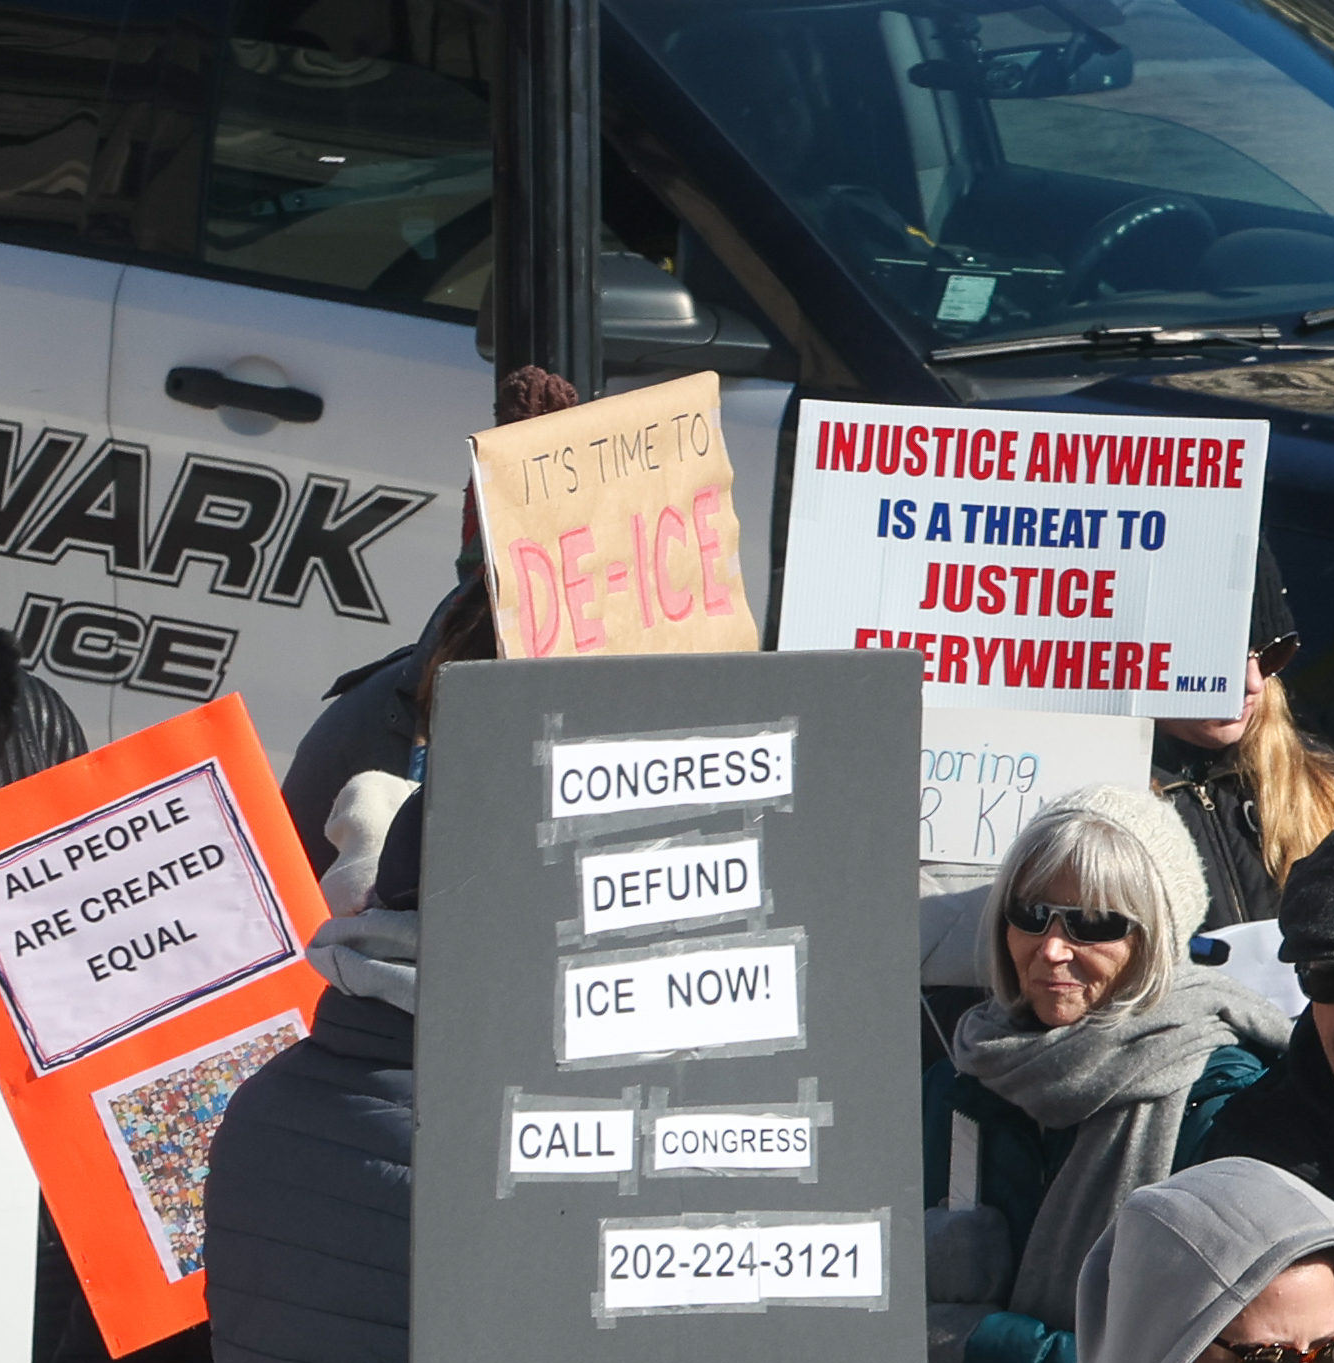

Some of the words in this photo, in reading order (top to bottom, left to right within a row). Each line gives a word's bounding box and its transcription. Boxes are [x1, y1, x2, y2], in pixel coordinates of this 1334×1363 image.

[523, 447, 579, 506] IT'S
[589, 429, 661, 486] TIME
[671, 412, 710, 460] TO
[815, 420, 1018, 482] INJUSTICE
[1026, 429, 1248, 490] ANYWHERE
[877, 498, 917, 540] IS
[925, 504, 952, 543] A
[960, 503, 1110, 549] THREAT
[1117, 509, 1167, 551] TO
[509, 483, 735, 658] DE-ICE
[919, 562, 1116, 619] JUSTICE
[1176, 674, 1207, 693] MLK
[1209, 676, 1228, 694] JR
[560, 748, 783, 805] CONGRESS:
[4, 851, 62, 900] ALL
[64, 798, 189, 873] PEOPLE
[974, 788, 1049, 857] KI
[14, 908, 76, 957] ARE
[79, 844, 226, 925] CREATED
[593, 857, 748, 911] DEFUND
[87, 918, 197, 983] EQUAL
[575, 978, 635, 1018] ICE
[667, 965, 771, 1008] NOW!
[518, 1121, 615, 1158] CALL
[662, 1128, 808, 1154] CONGRESS
[610, 1241, 860, 1280] 202-224-3121
